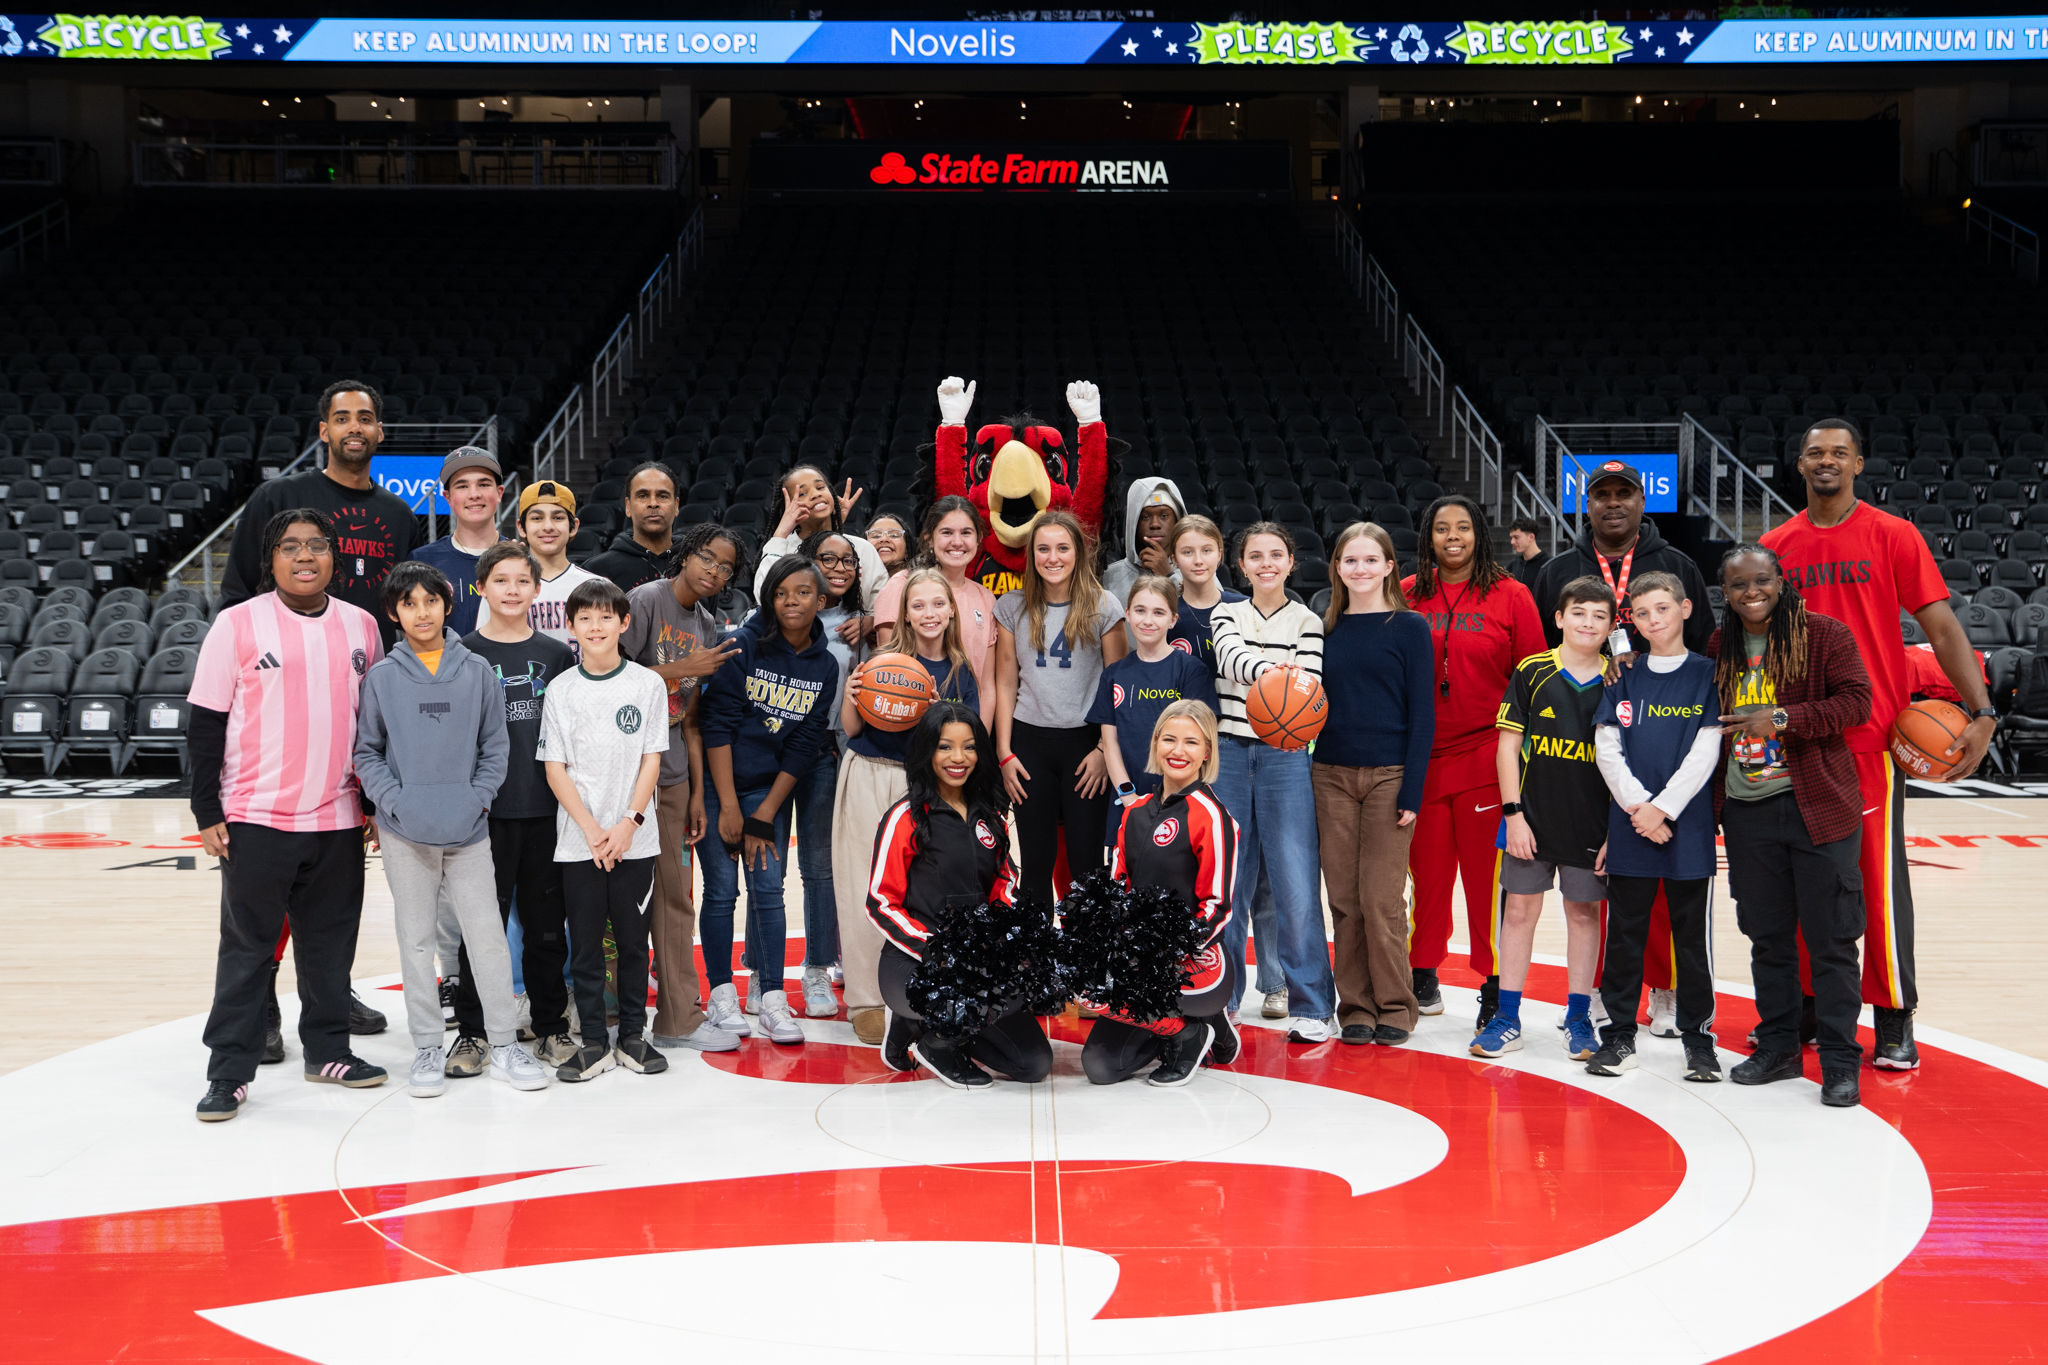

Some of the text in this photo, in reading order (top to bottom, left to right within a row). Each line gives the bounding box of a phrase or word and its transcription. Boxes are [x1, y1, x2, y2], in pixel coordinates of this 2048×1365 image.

[59, 21, 207, 51] RECYCLE
[353, 31, 758, 54] KEEP ALUMINUM IN THE LOOP!
[890, 28, 1016, 58] Novelis
[1215, 27, 1338, 59] PLEASE
[1466, 26, 1608, 57] RECYCLE
[1755, 32, 1818, 53] KEEP
[1826, 29, 1977, 52] ALUMINUM
[1986, 28, 2015, 51] IN
[919, 153, 1169, 185] State Farm ARENA
[982, 572, 1024, 595] HAW
[1786, 560, 1871, 589] HAWKS
[1425, 612, 1485, 632] AWKS
[1035, 625, 1072, 669] 14
[780, 675, 788, 685] T.
[875, 672, 926, 693] Wilson
[419, 702, 450, 713] PUMA
[754, 701, 779, 715] MIDDLE
[1531, 735, 1596, 763] TANZAN
